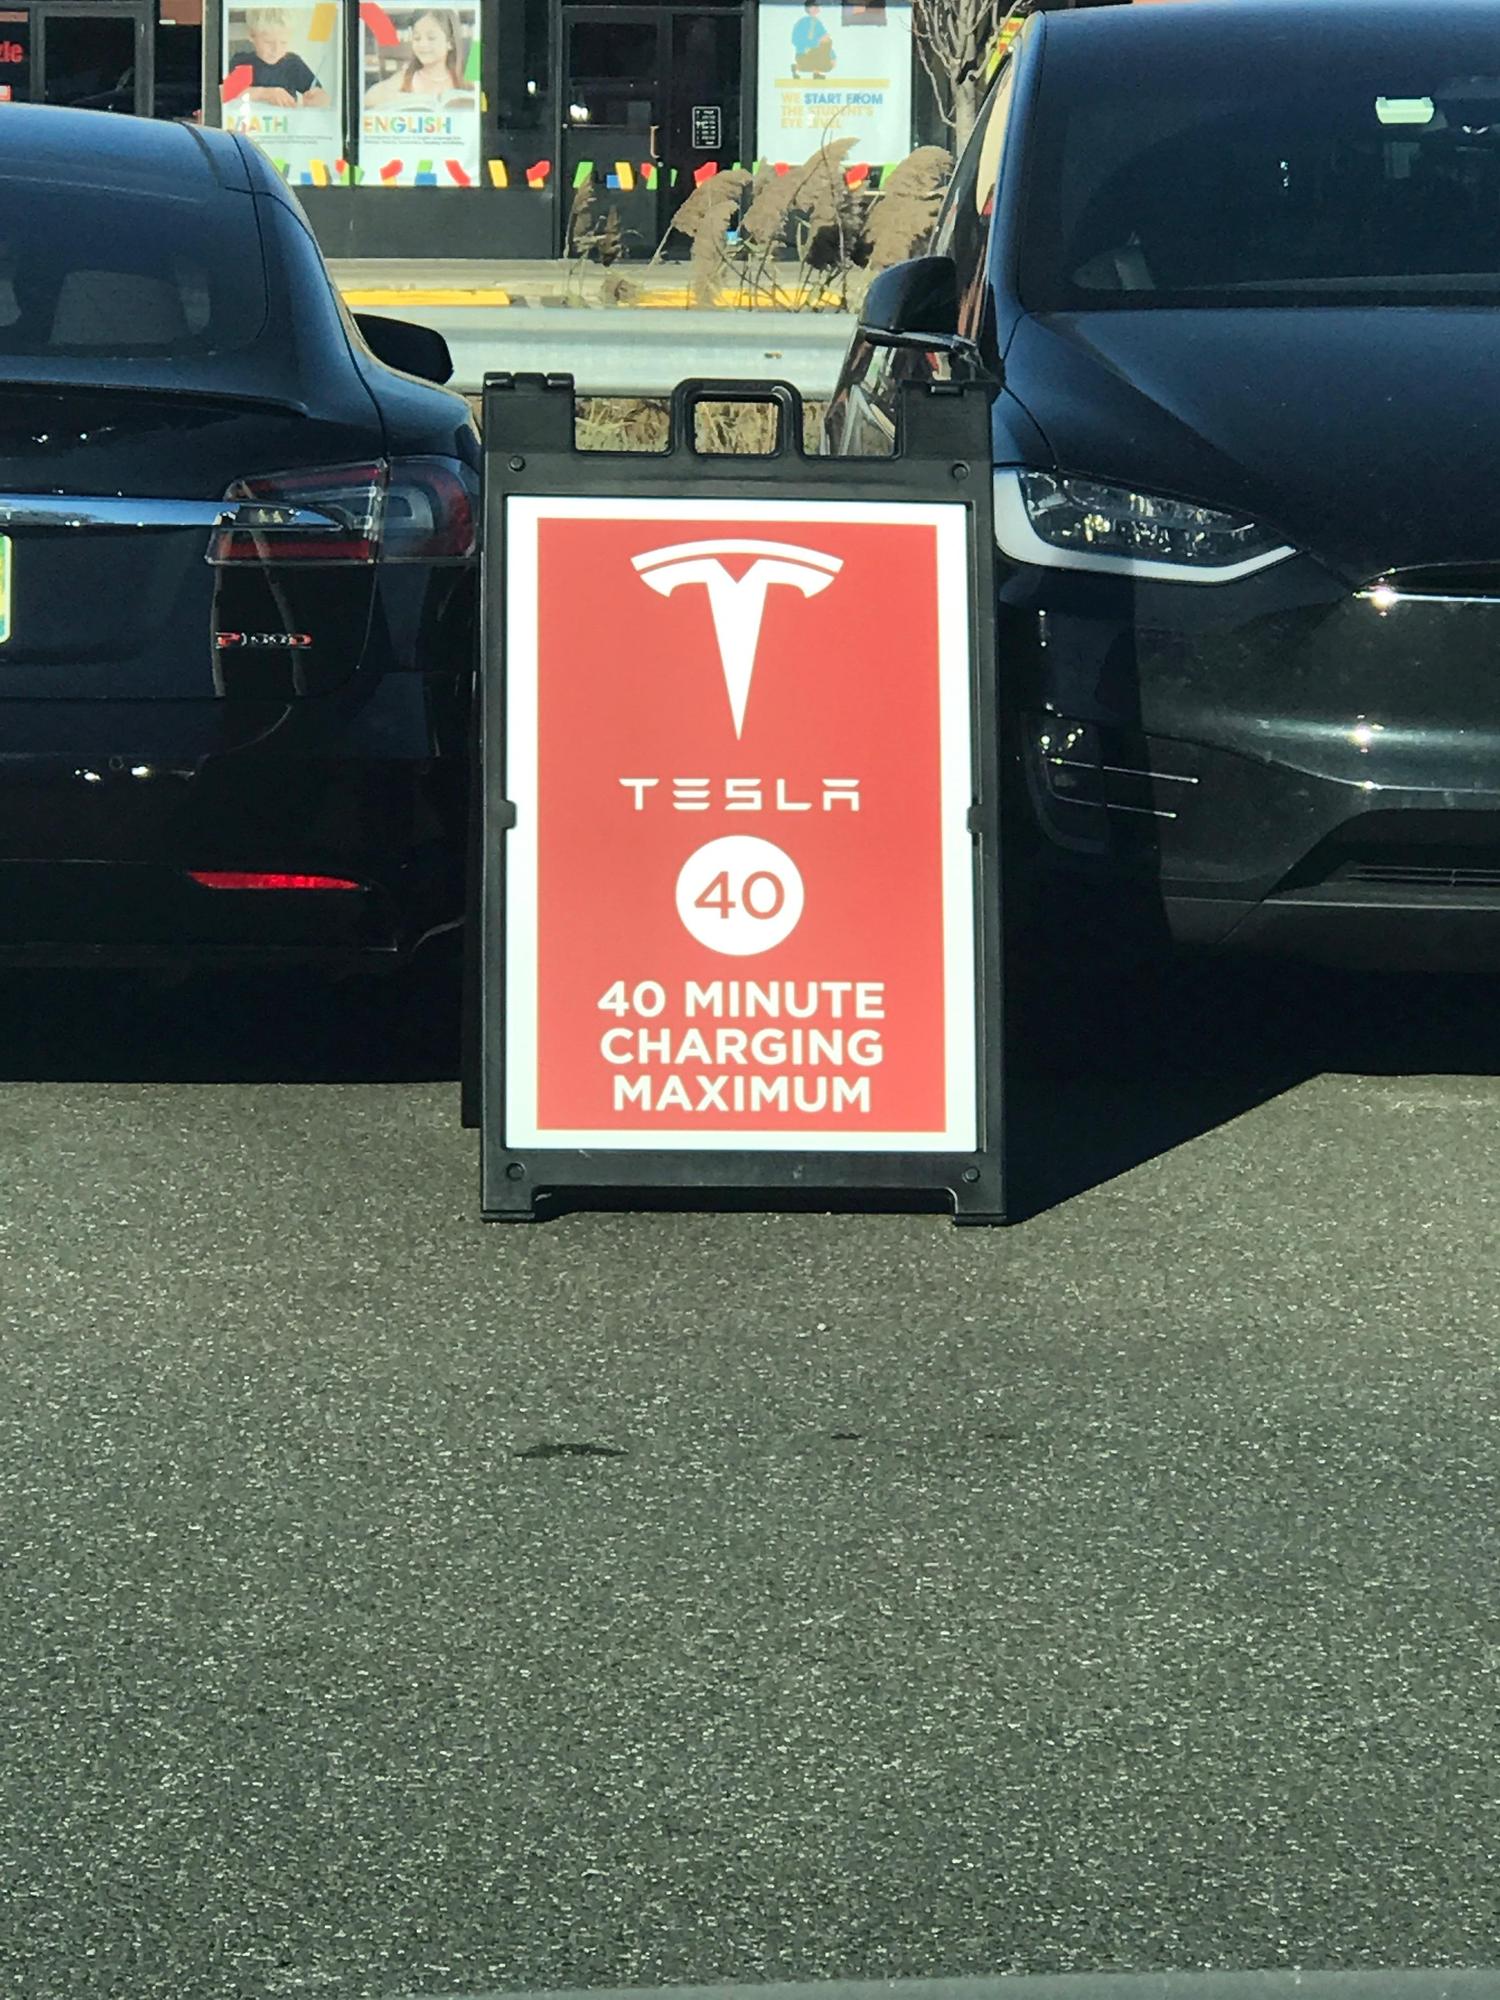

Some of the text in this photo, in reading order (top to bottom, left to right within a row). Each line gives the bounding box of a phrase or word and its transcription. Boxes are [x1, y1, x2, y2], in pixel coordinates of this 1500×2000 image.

[804, 93, 842, 104] START
[846, 93, 883, 104] FROM
[226, 115, 288, 133] MATH
[364, 116, 452, 134] ENGLISH
[619, 778, 862, 811] TESLA
[695, 871, 785, 920] 40
[598, 981, 885, 1019] 40 MINUTE
[600, 1028, 884, 1067] CHARGING
[613, 1075, 871, 1113] MAXIMUM
